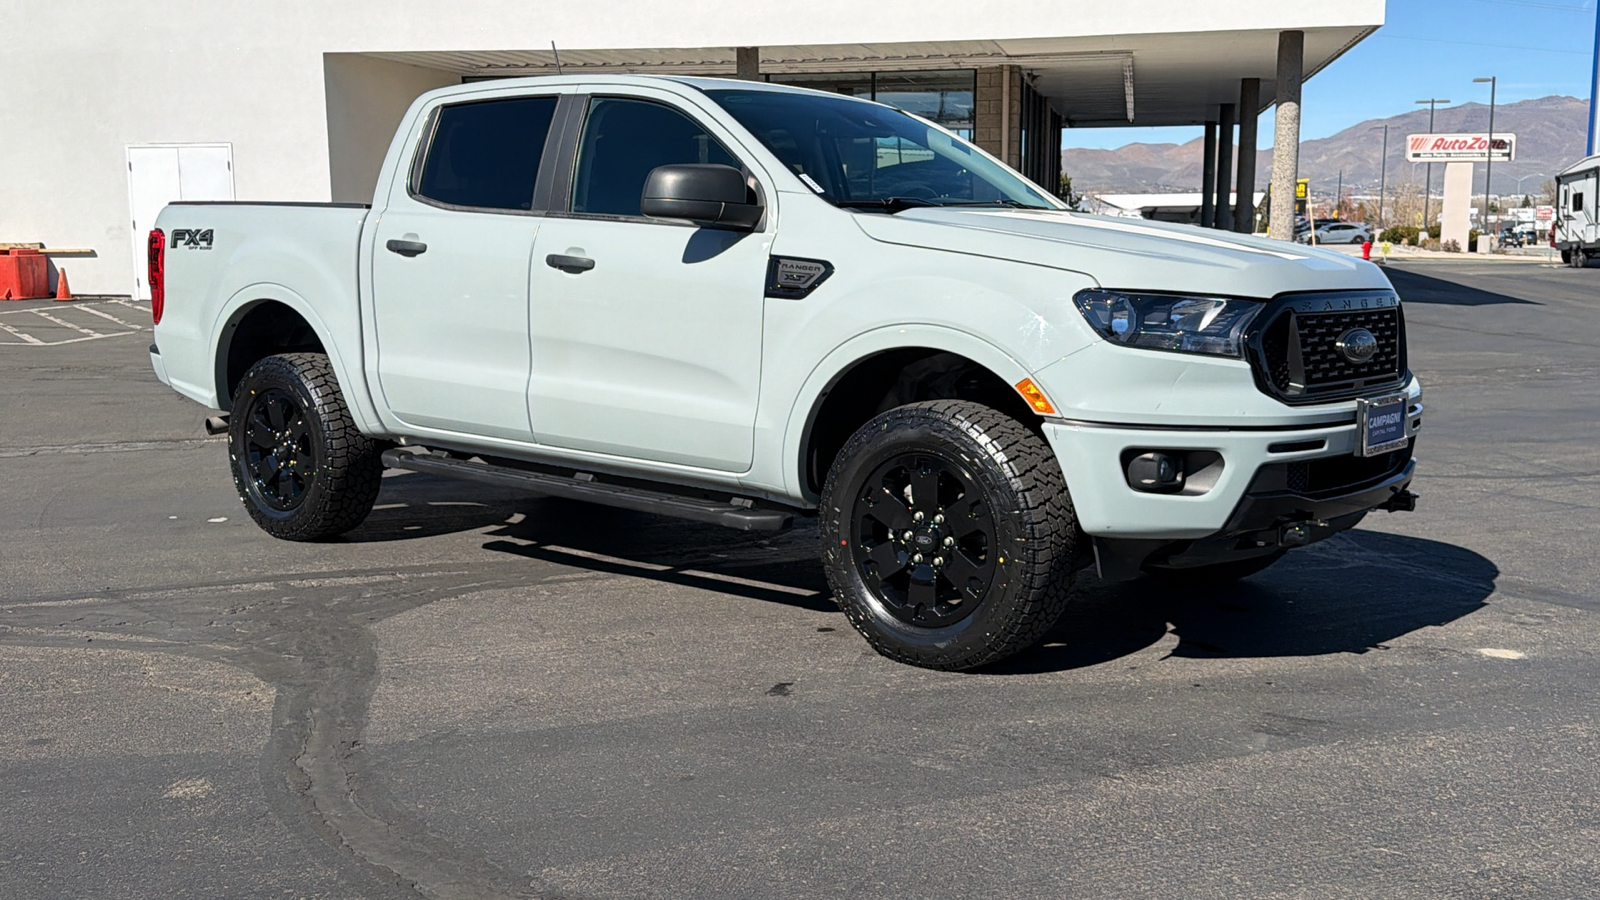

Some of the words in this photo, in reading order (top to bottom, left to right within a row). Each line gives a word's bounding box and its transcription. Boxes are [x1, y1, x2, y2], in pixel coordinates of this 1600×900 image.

[1430, 137, 1507, 150] AutoZone
[170, 229, 214, 248] FX4
[781, 263, 821, 272] RANGER
[1302, 297, 1396, 310] RANGER
[1369, 412, 1401, 428] CAMPAGNI
